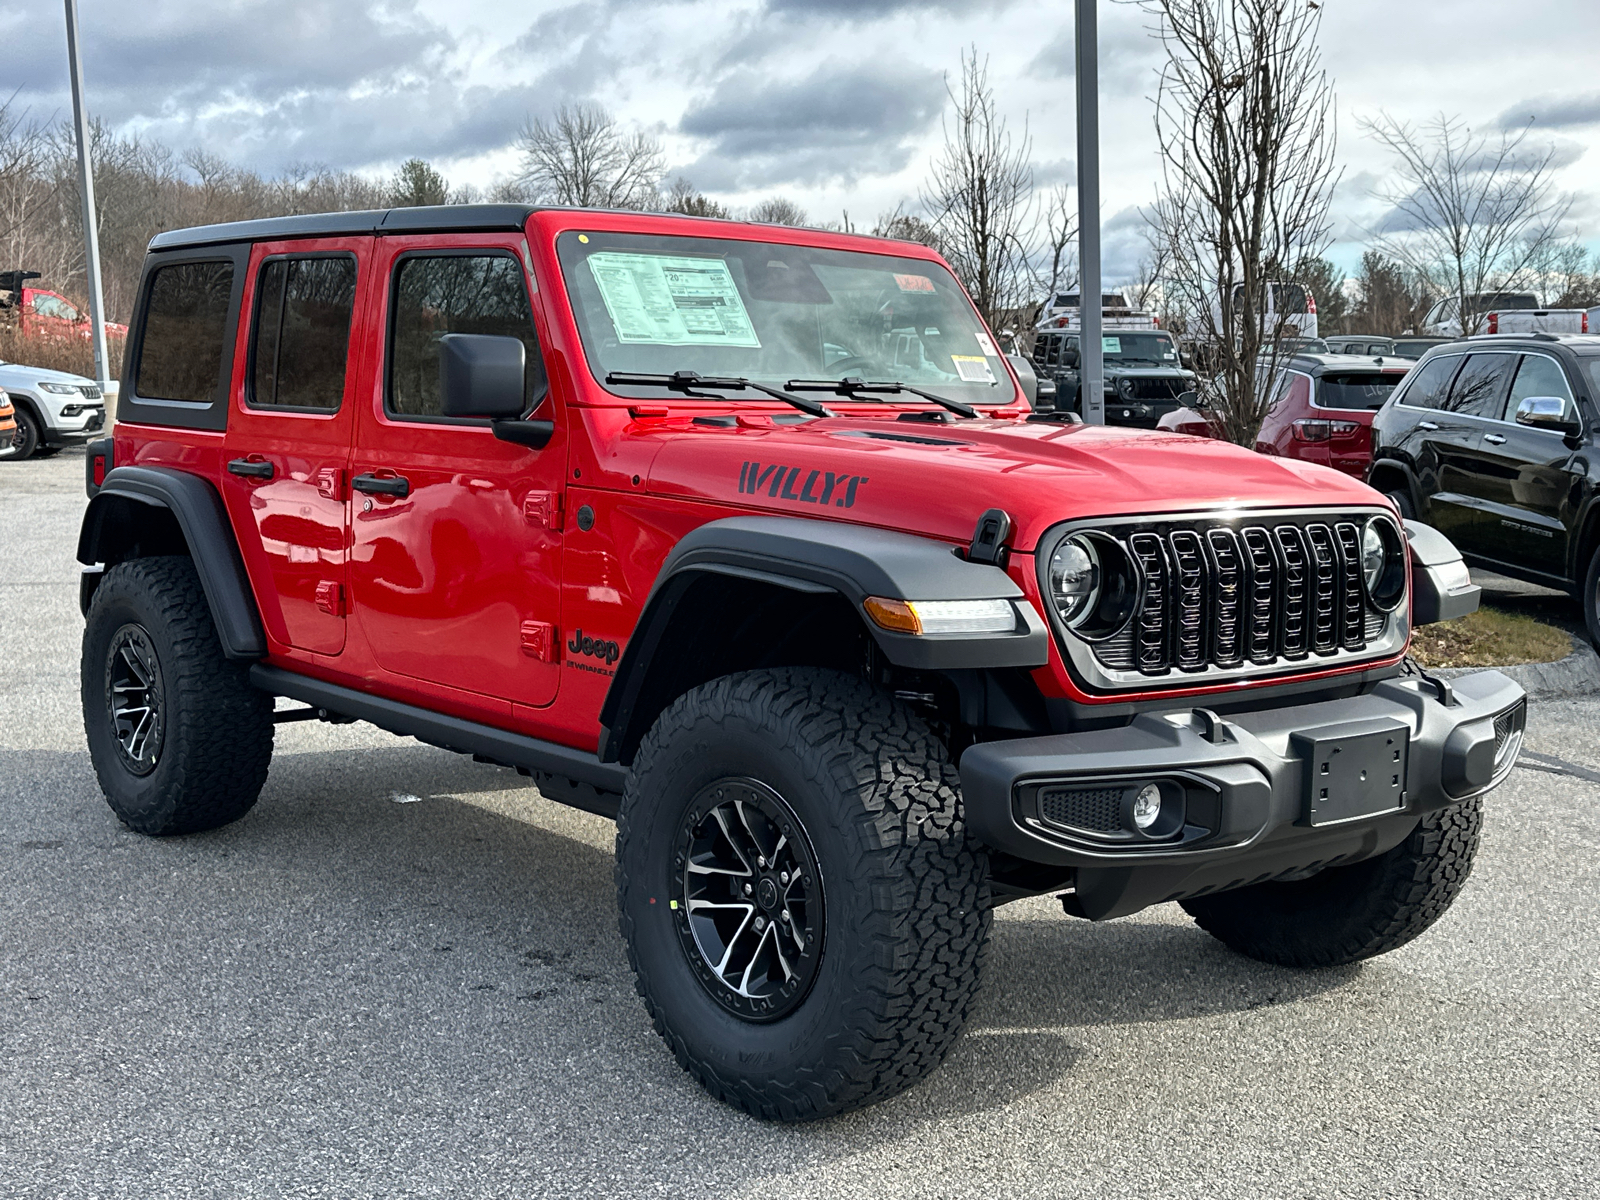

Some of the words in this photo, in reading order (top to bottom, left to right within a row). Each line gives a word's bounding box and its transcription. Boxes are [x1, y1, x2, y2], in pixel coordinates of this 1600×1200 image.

[738, 461, 870, 508] WILLYS
[568, 628, 619, 666] Jeep
[574, 662, 614, 677] WRANGLE
